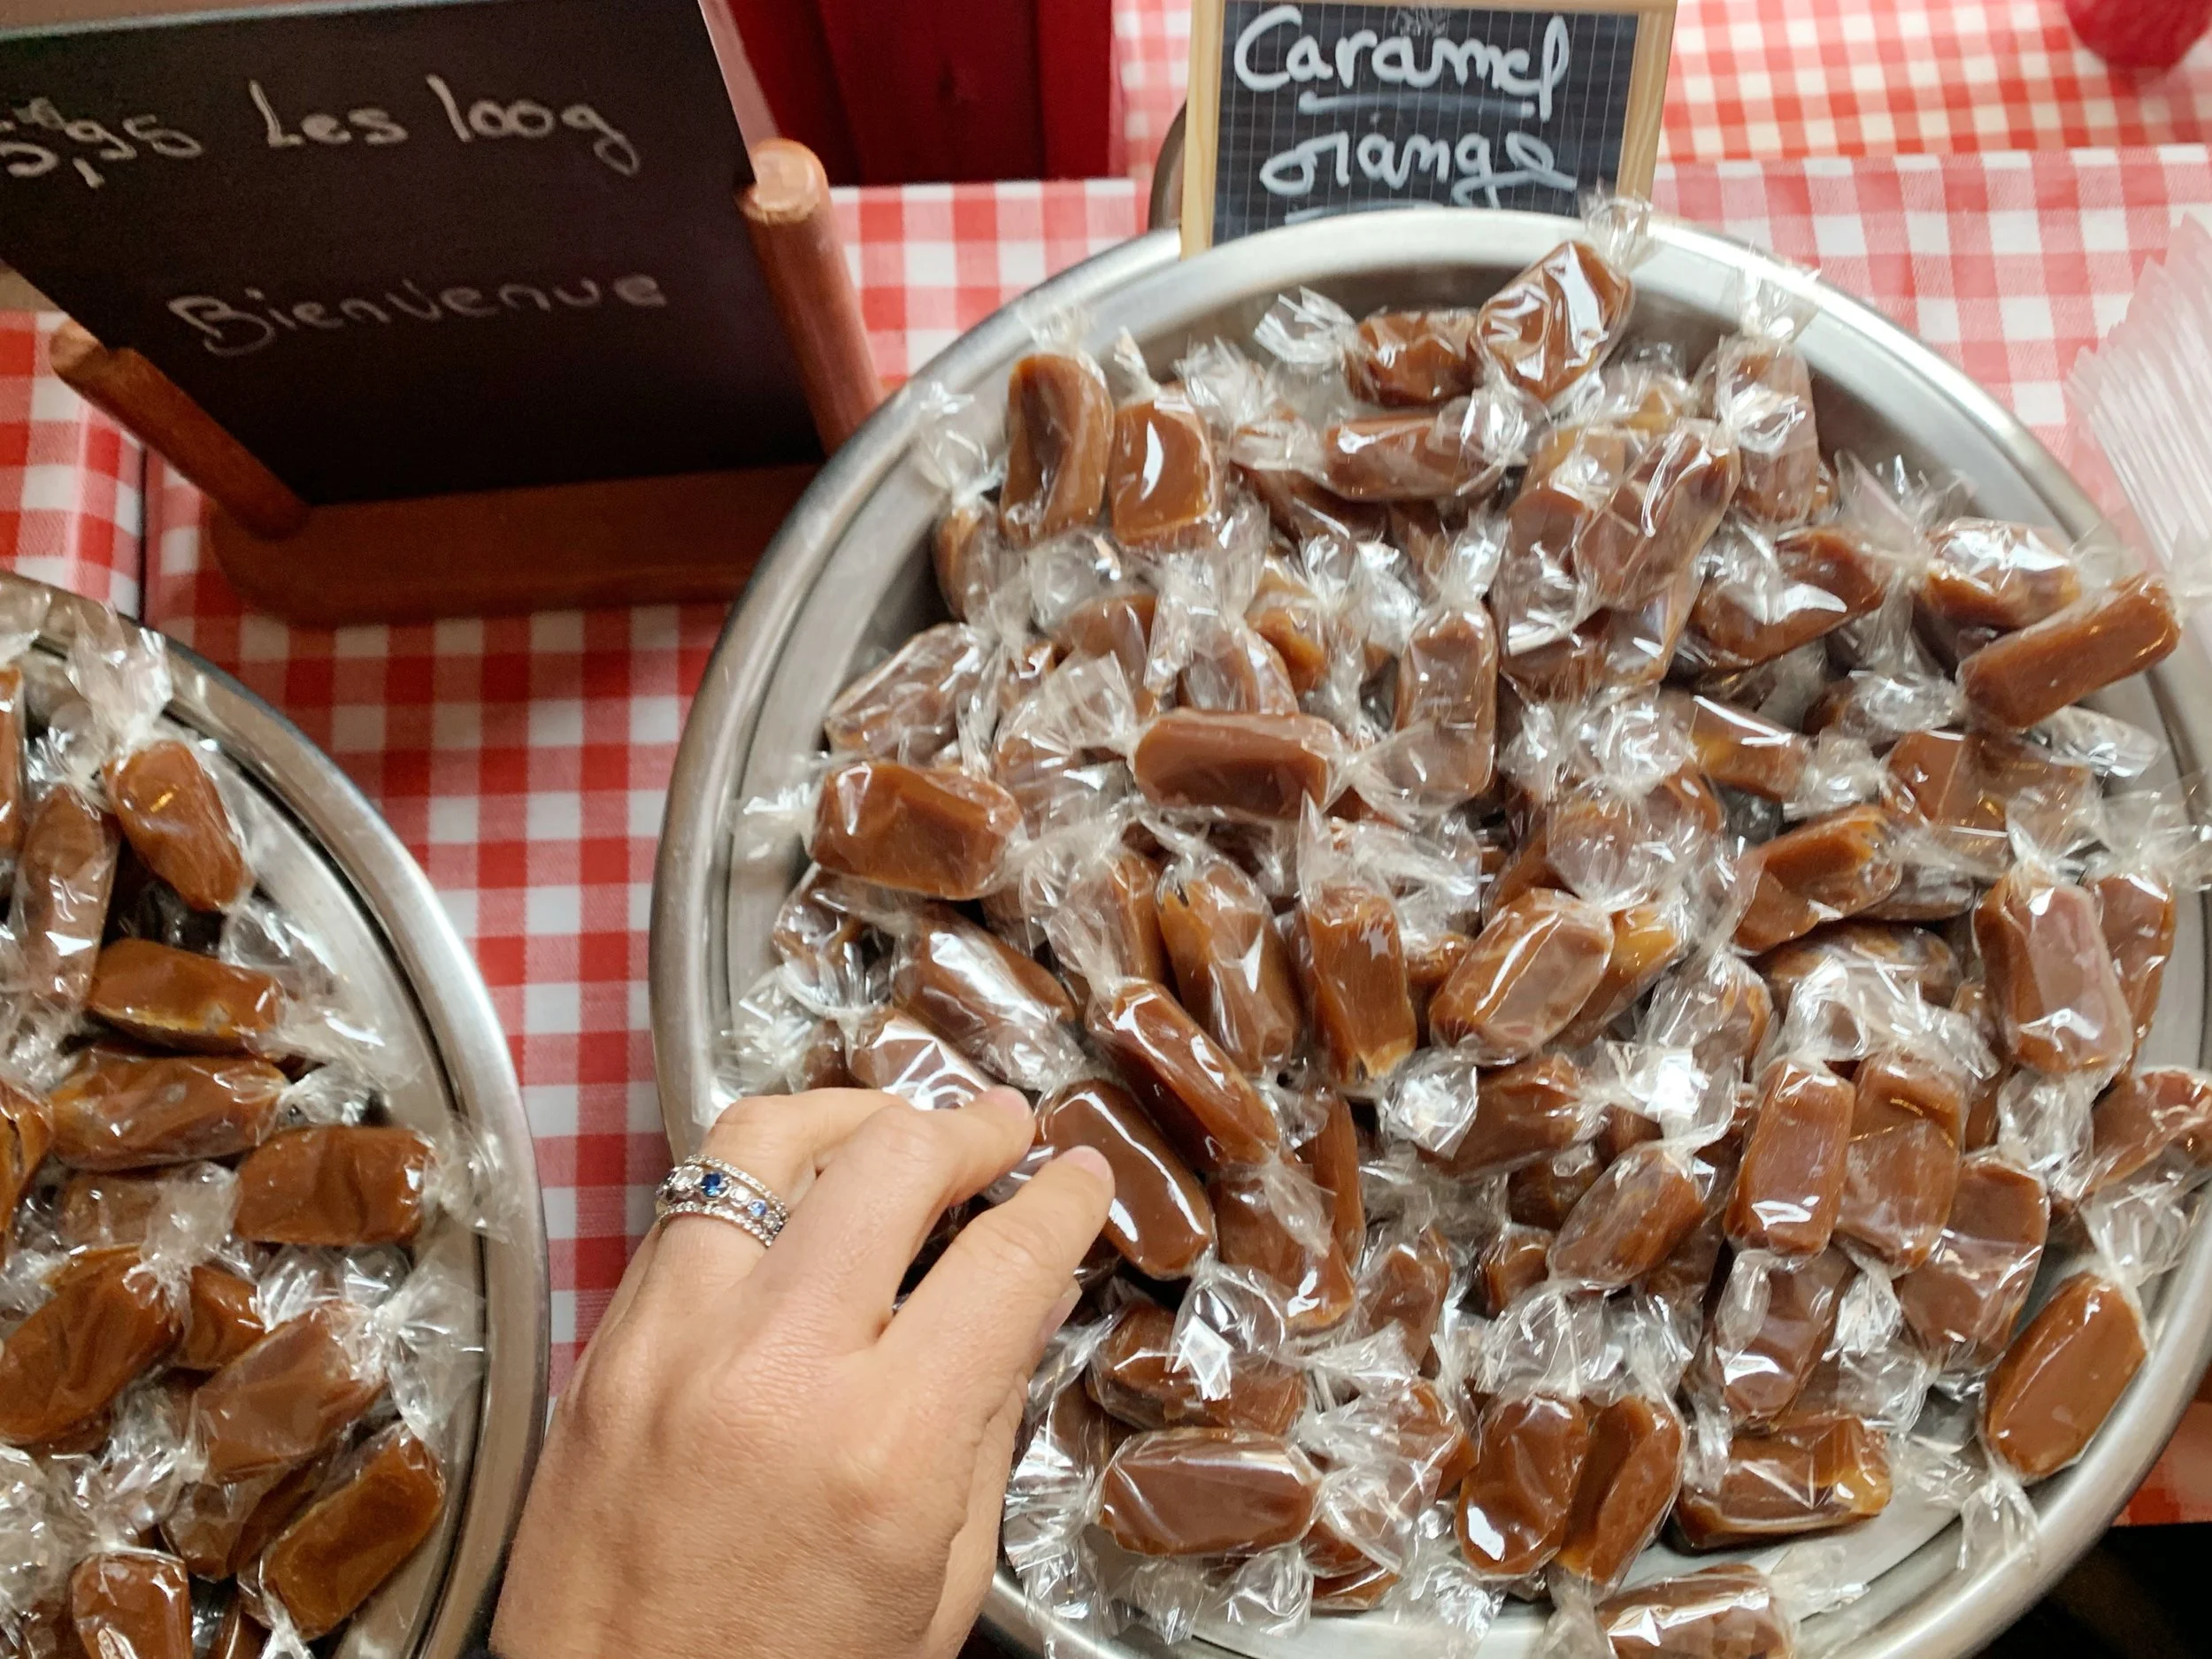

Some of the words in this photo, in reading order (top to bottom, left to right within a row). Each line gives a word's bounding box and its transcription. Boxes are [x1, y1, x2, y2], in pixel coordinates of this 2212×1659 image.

[1233, 4, 1571, 122] Caramel
[425, 73, 640, 176] 100g
[167, 273, 668, 357] Bienvenue
